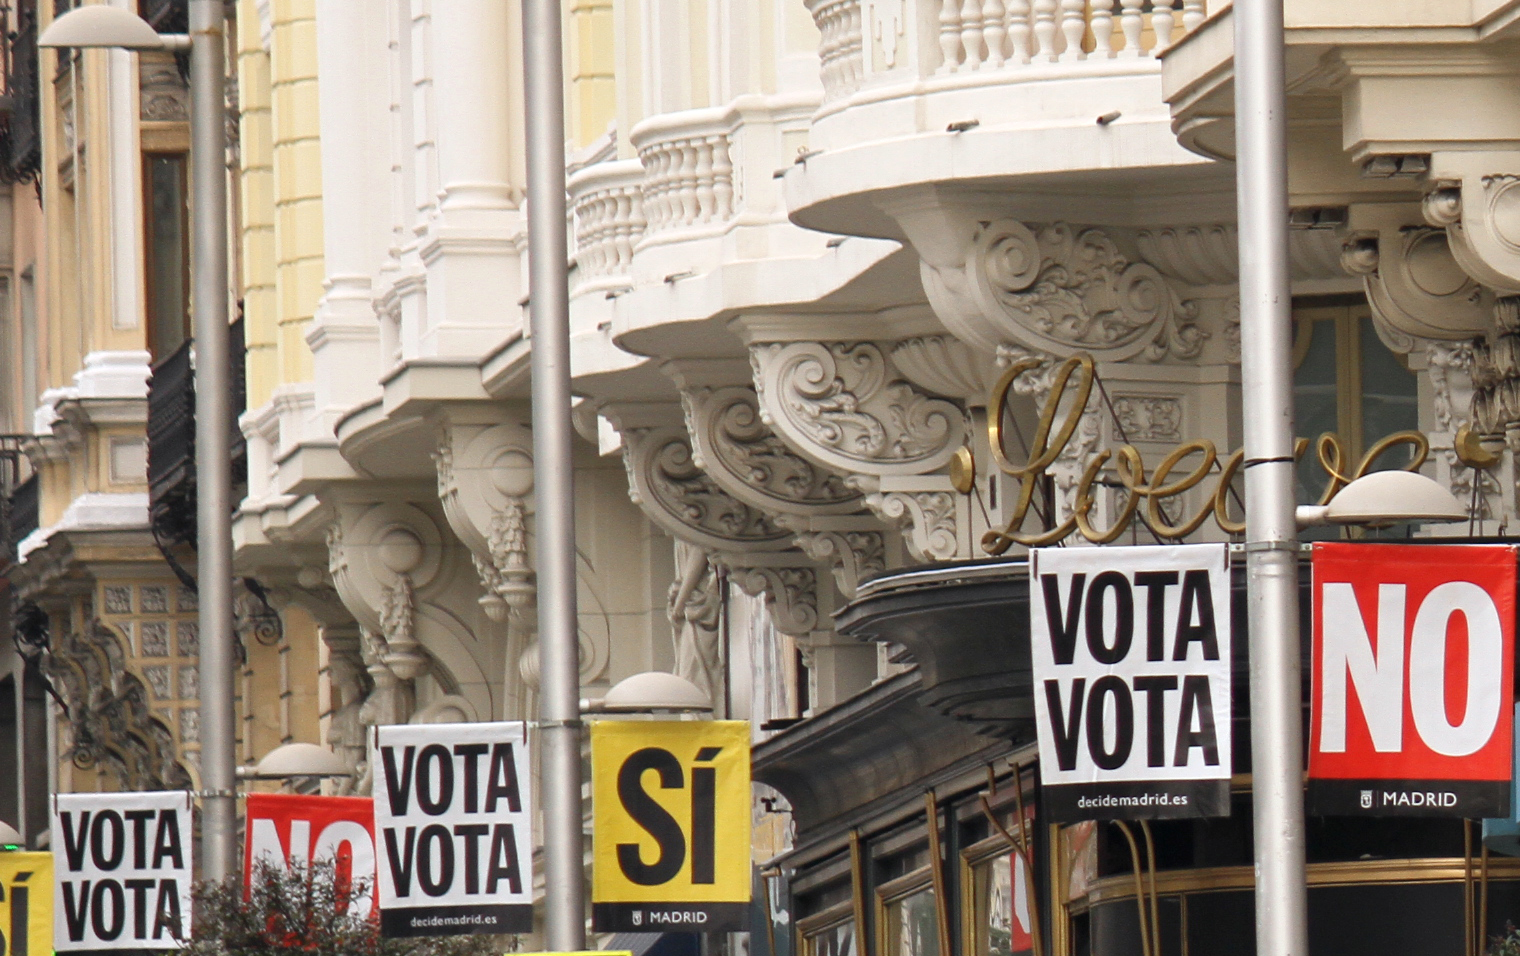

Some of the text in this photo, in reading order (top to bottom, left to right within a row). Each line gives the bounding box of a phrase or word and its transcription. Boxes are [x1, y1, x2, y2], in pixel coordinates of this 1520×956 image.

[1041, 570, 1220, 665] VOTA
[1319, 581, 1503, 757] NO
[1045, 675, 1220, 772] VOTA
[381, 743, 522, 817] VOTA
[616, 746, 723, 887] Sí
[1077, 792, 1188, 809] decidemadrid.es
[1383, 792, 1458, 808] MADRID
[61, 809, 184, 872] VOTA
[250, 818, 376, 932] NO
[384, 823, 523, 899] VOTA
[62, 878, 185, 942] VOTA
[410, 914, 498, 927] decidemadrid.es
[649, 911, 708, 924] MADRID
